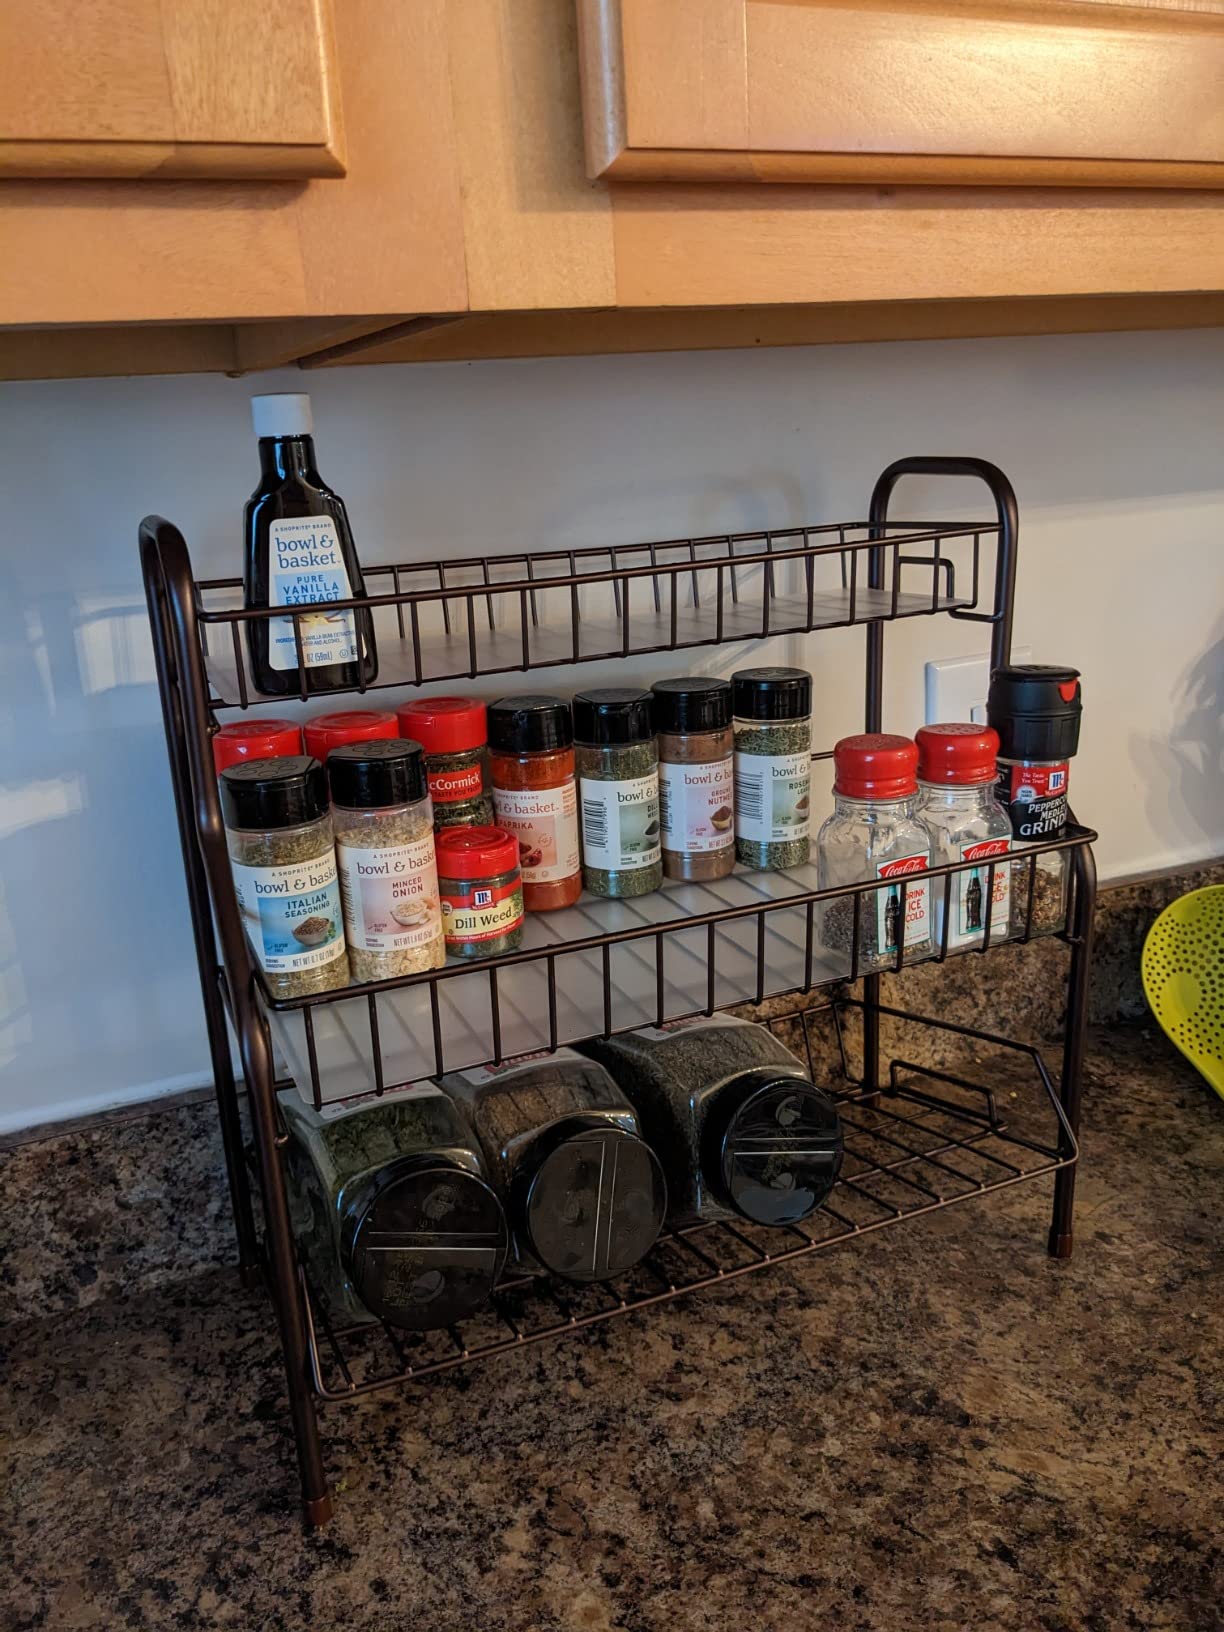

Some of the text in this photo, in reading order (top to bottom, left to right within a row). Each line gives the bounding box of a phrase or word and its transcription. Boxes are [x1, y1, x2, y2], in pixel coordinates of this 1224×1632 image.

[275, 534, 334, 552] bowl &
[278, 551, 336, 569] basket
[296, 574, 324, 584] PURE
[283, 582, 339, 595] VANILLA
[286, 592, 340, 606] EXTRACT
[684, 772, 712, 784] bowl
[714, 772, 722, 782] &
[772, 764, 806, 778] bowl &
[430, 771, 480, 790] cCormick
[616, 789, 644, 802] bowl
[646, 788, 652, 797] &
[504, 804, 512, 812] &
[514, 802, 556, 814] basket
[356, 862, 390, 874] bowl
[394, 861, 406, 872] &
[254, 880, 290, 894] bowl
[294, 879, 306, 890] &
[392, 876, 422, 889] MINCED
[392, 884, 424, 898] ONION
[288, 892, 327, 910] ITALIAN
[908, 900, 922, 912] ICE
[285, 900, 330, 918] SEASONING
[455, 906, 512, 929] Dill Weed
[906, 910, 925, 923] COLD
